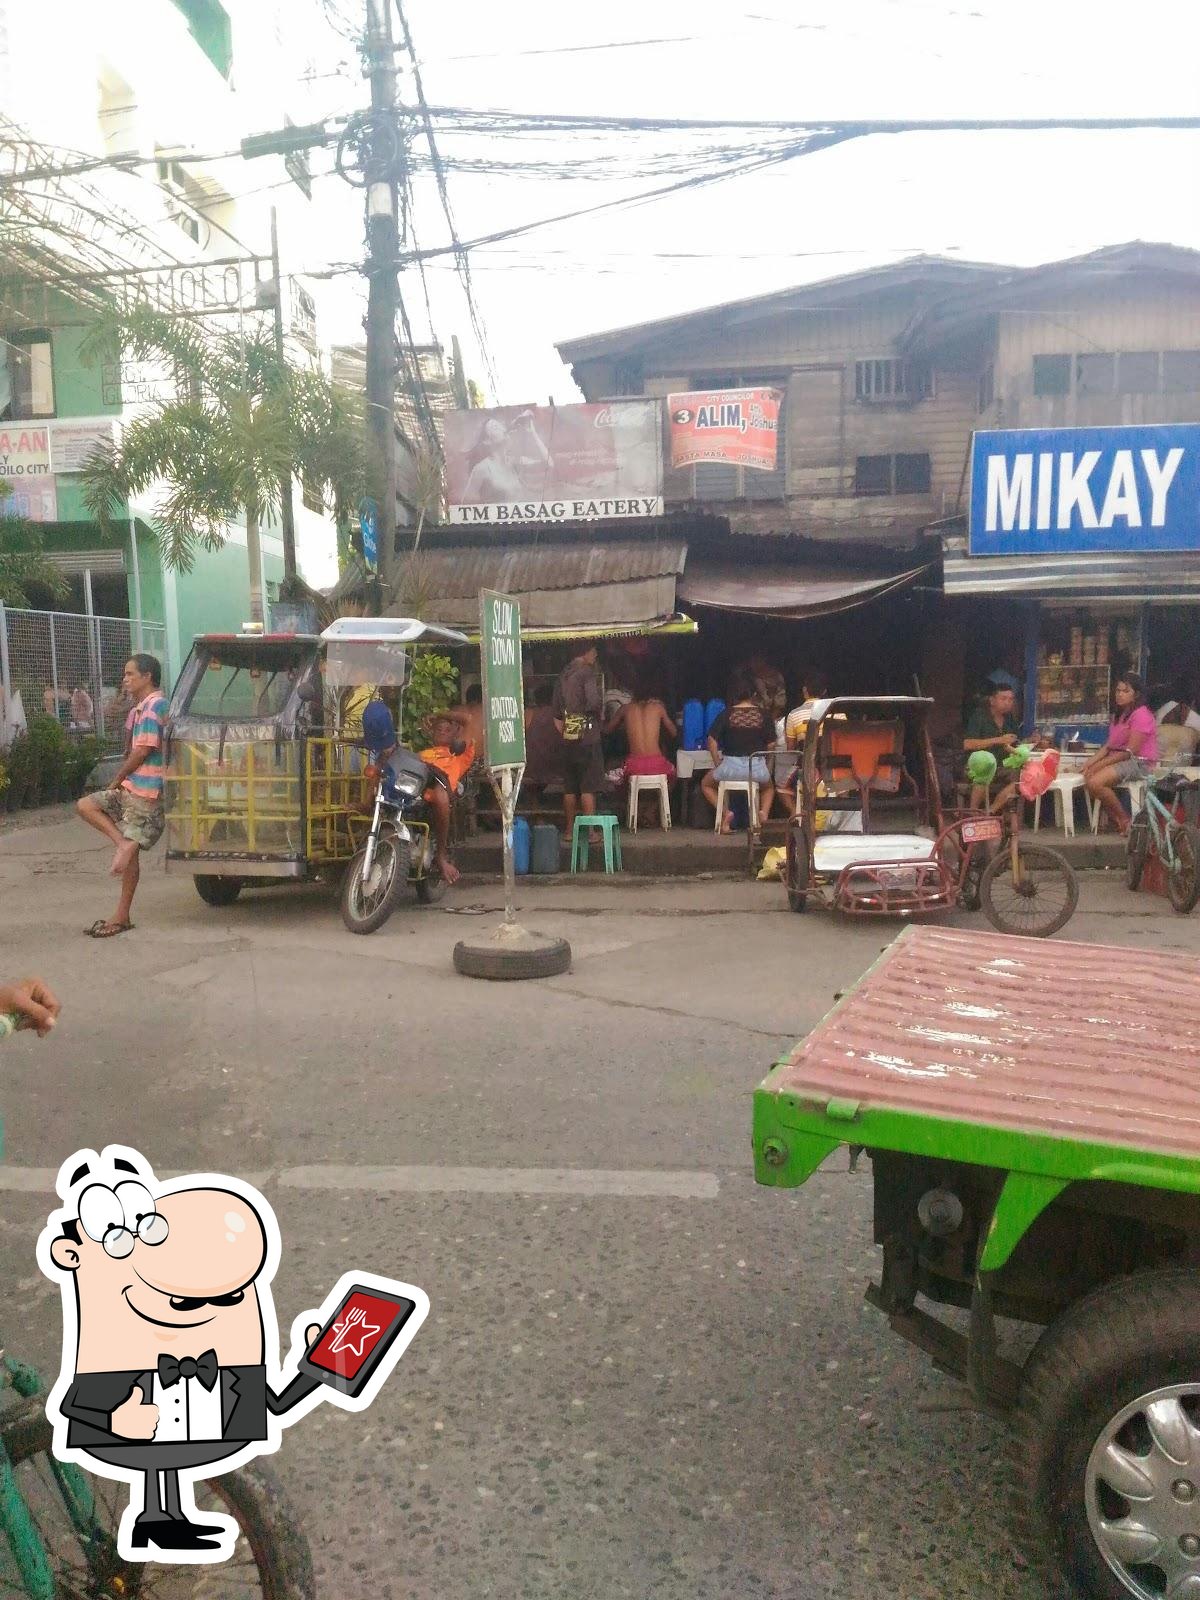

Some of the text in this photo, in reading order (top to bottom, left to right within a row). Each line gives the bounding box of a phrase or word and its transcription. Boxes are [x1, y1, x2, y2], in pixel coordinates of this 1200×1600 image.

[677, 409, 690, 424] 3
[26, 463, 49, 475] CITY
[985, 448, 1185, 531] MIKAY
[458, 499, 658, 521] TM BASAG EATERY
[492, 600, 513, 635] SLOW
[491, 637, 515, 666] DOWN
